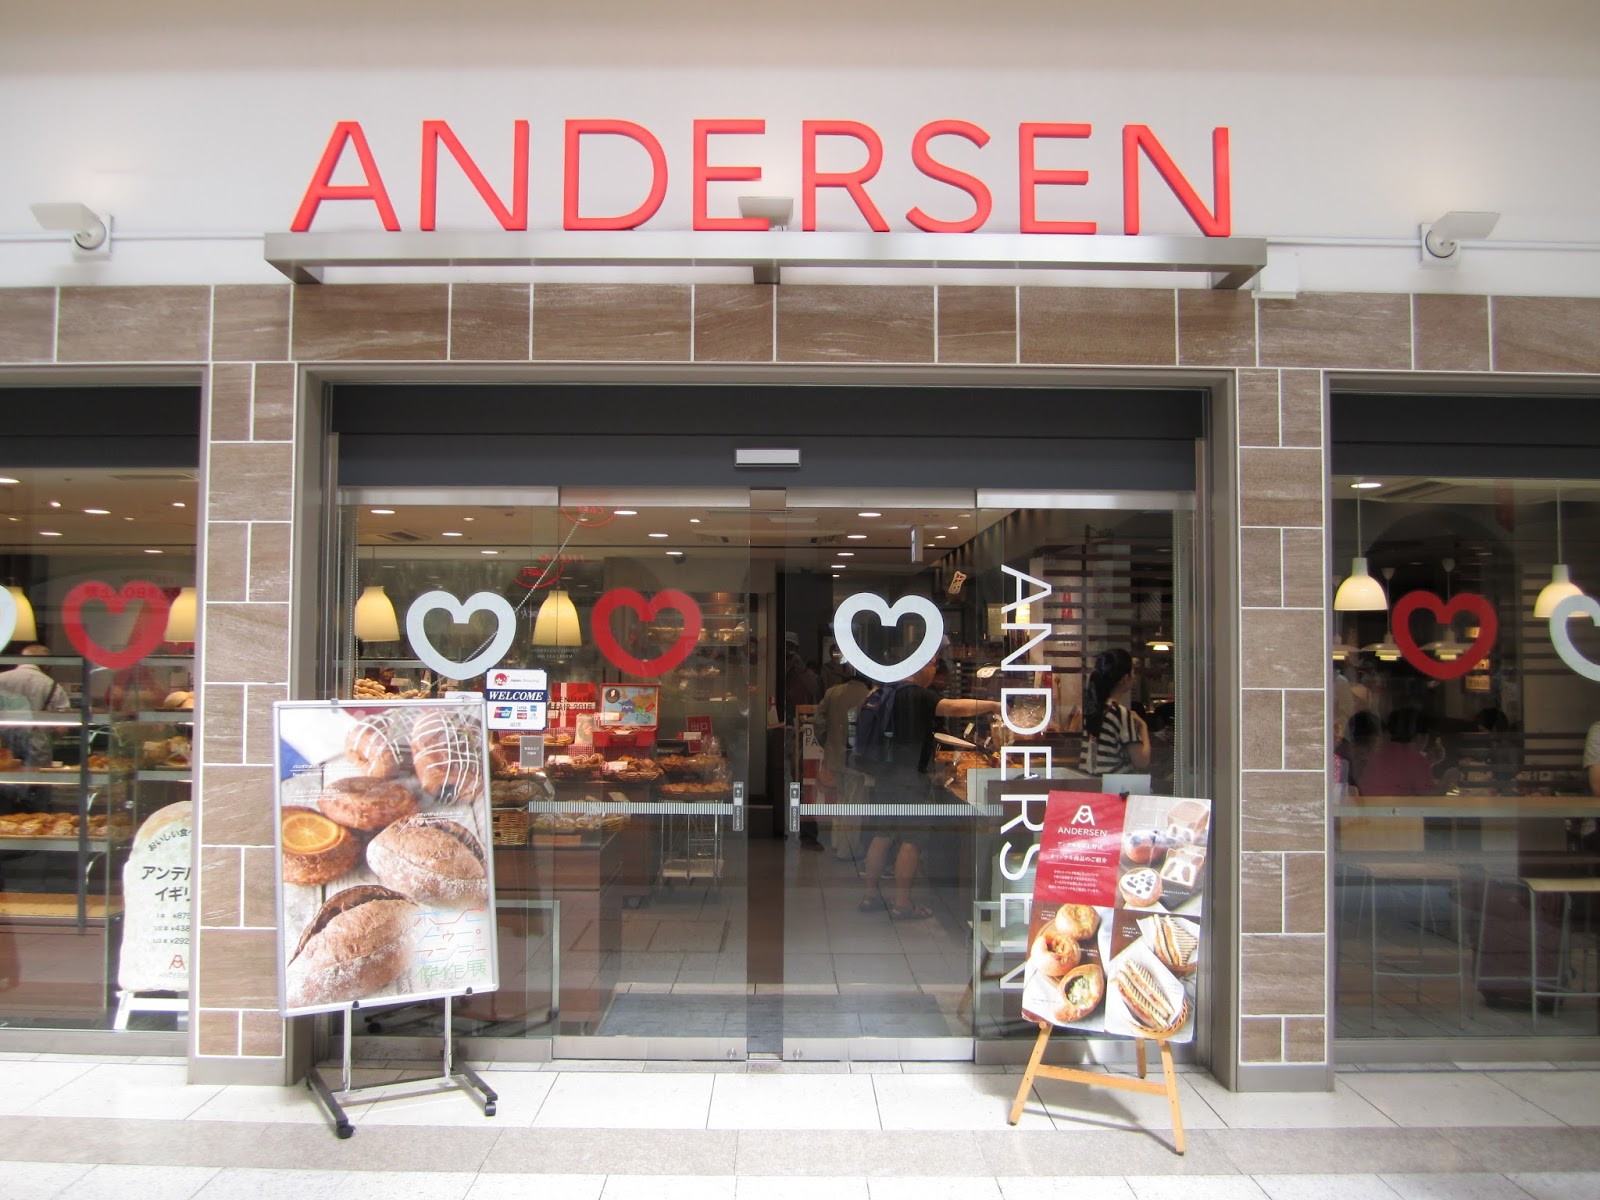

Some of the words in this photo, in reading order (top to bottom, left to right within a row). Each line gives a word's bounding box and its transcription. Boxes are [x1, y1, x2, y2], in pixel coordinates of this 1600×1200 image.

[289, 118, 1233, 237] ANDERSEN
[489, 691, 544, 701] WELCOME
[1057, 827, 1108, 837] ANDERSEN
[415, 959, 487, 984] 傑作展
